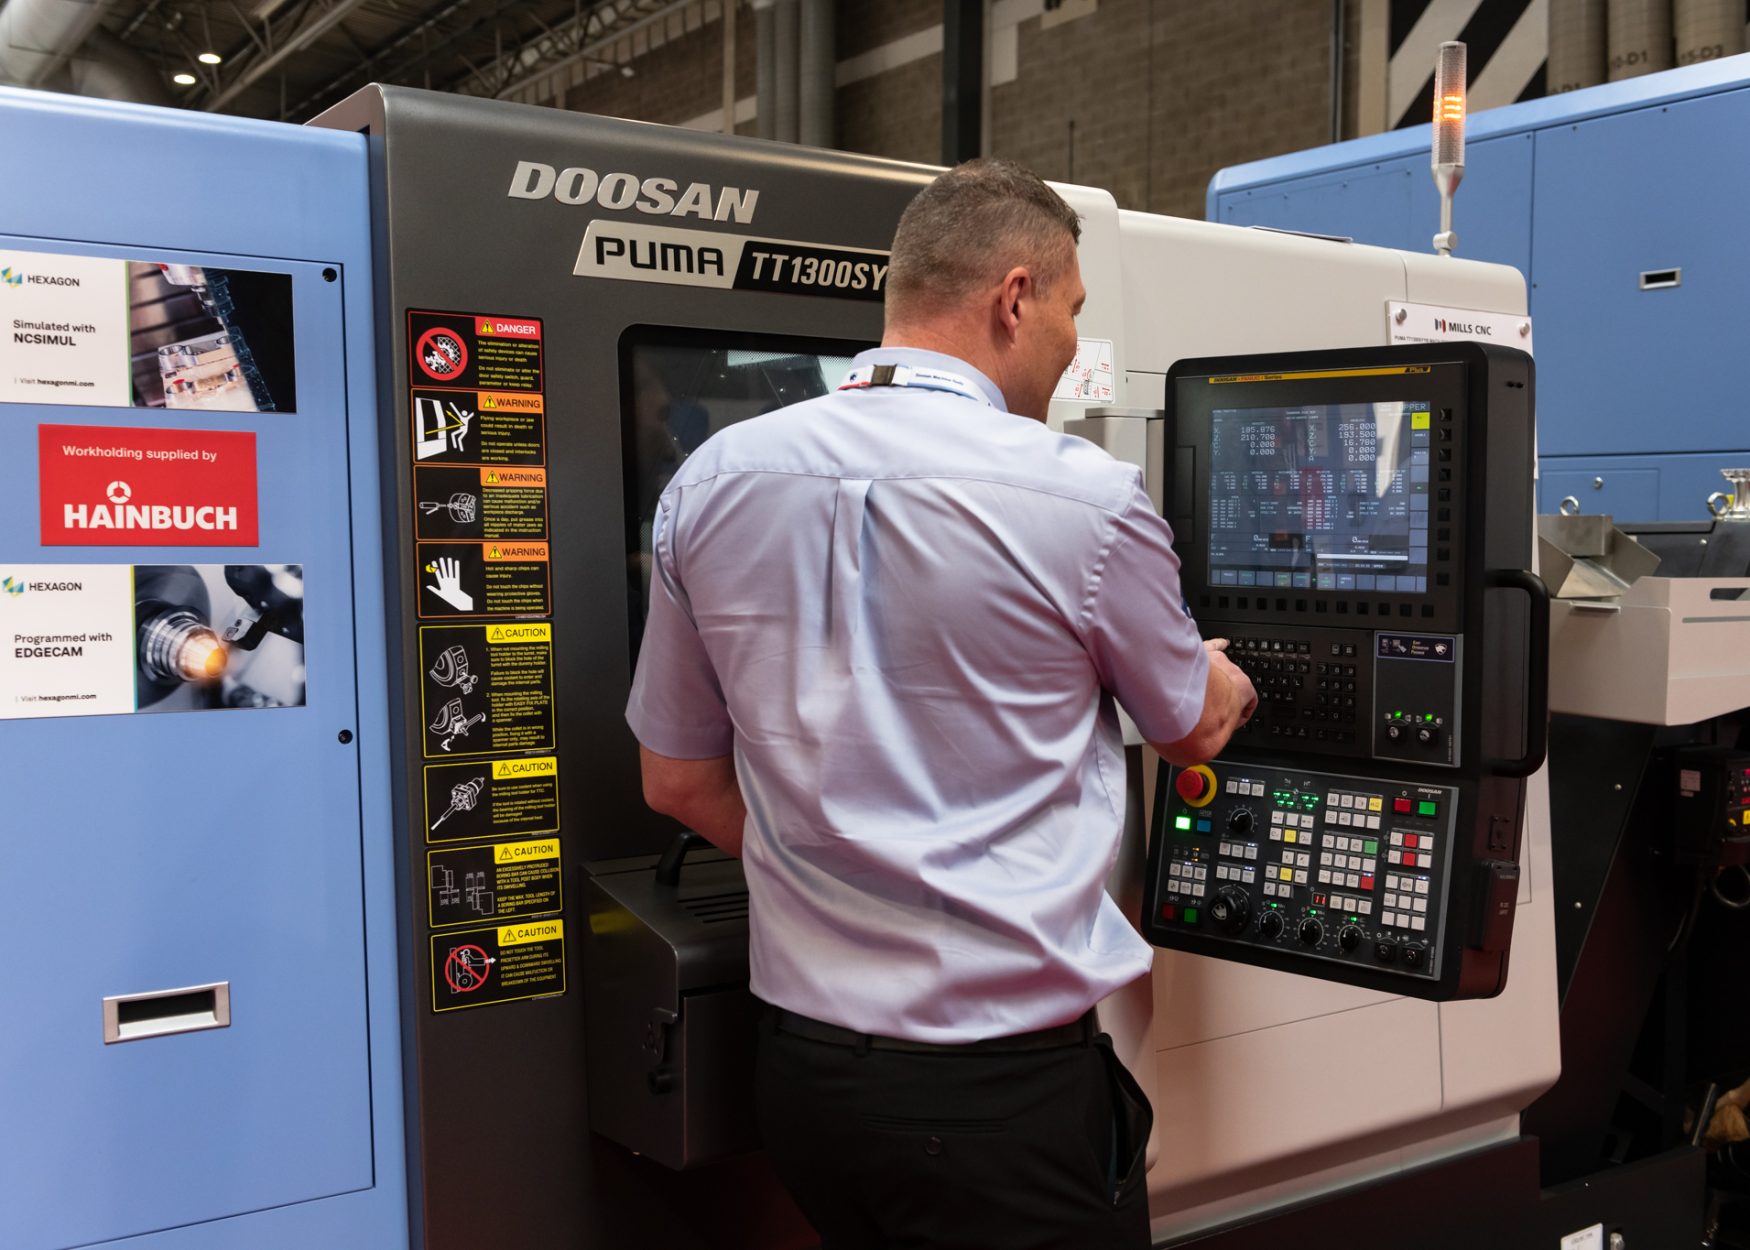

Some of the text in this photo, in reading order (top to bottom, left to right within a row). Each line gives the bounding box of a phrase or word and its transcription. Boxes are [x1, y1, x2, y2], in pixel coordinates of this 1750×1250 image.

[508, 160, 759, 224] DOOSAN
[595, 236, 888, 291] PUMA TT1300SY
[27, 275, 80, 287] HEXAGON
[13, 319, 96, 333] Simulated with
[497, 323, 536, 335] DANGER
[1449, 322, 1492, 336] MILLS CNC
[14, 333, 76, 346] NCSIMUL
[20, 377, 95, 388] Visit hexagonmi.com
[496, 399, 540, 408] WARNING
[62, 446, 217, 462] Workholding supplied by
[499, 473, 543, 482] WARNING
[64, 504, 237, 530] HAINBUCH
[502, 547, 546, 556] WARNING
[29, 582, 82, 592] HEXAGON
[14, 632, 113, 646] Programmed with
[505, 628, 546, 638] CAUTION
[15, 646, 83, 659] EDGECAM
[38, 693, 97, 703] hexagonmi.com
[512, 762, 553, 773] CAUTION
[514, 845, 553, 856] CAUTION
[518, 926, 557, 938] CAUTION
